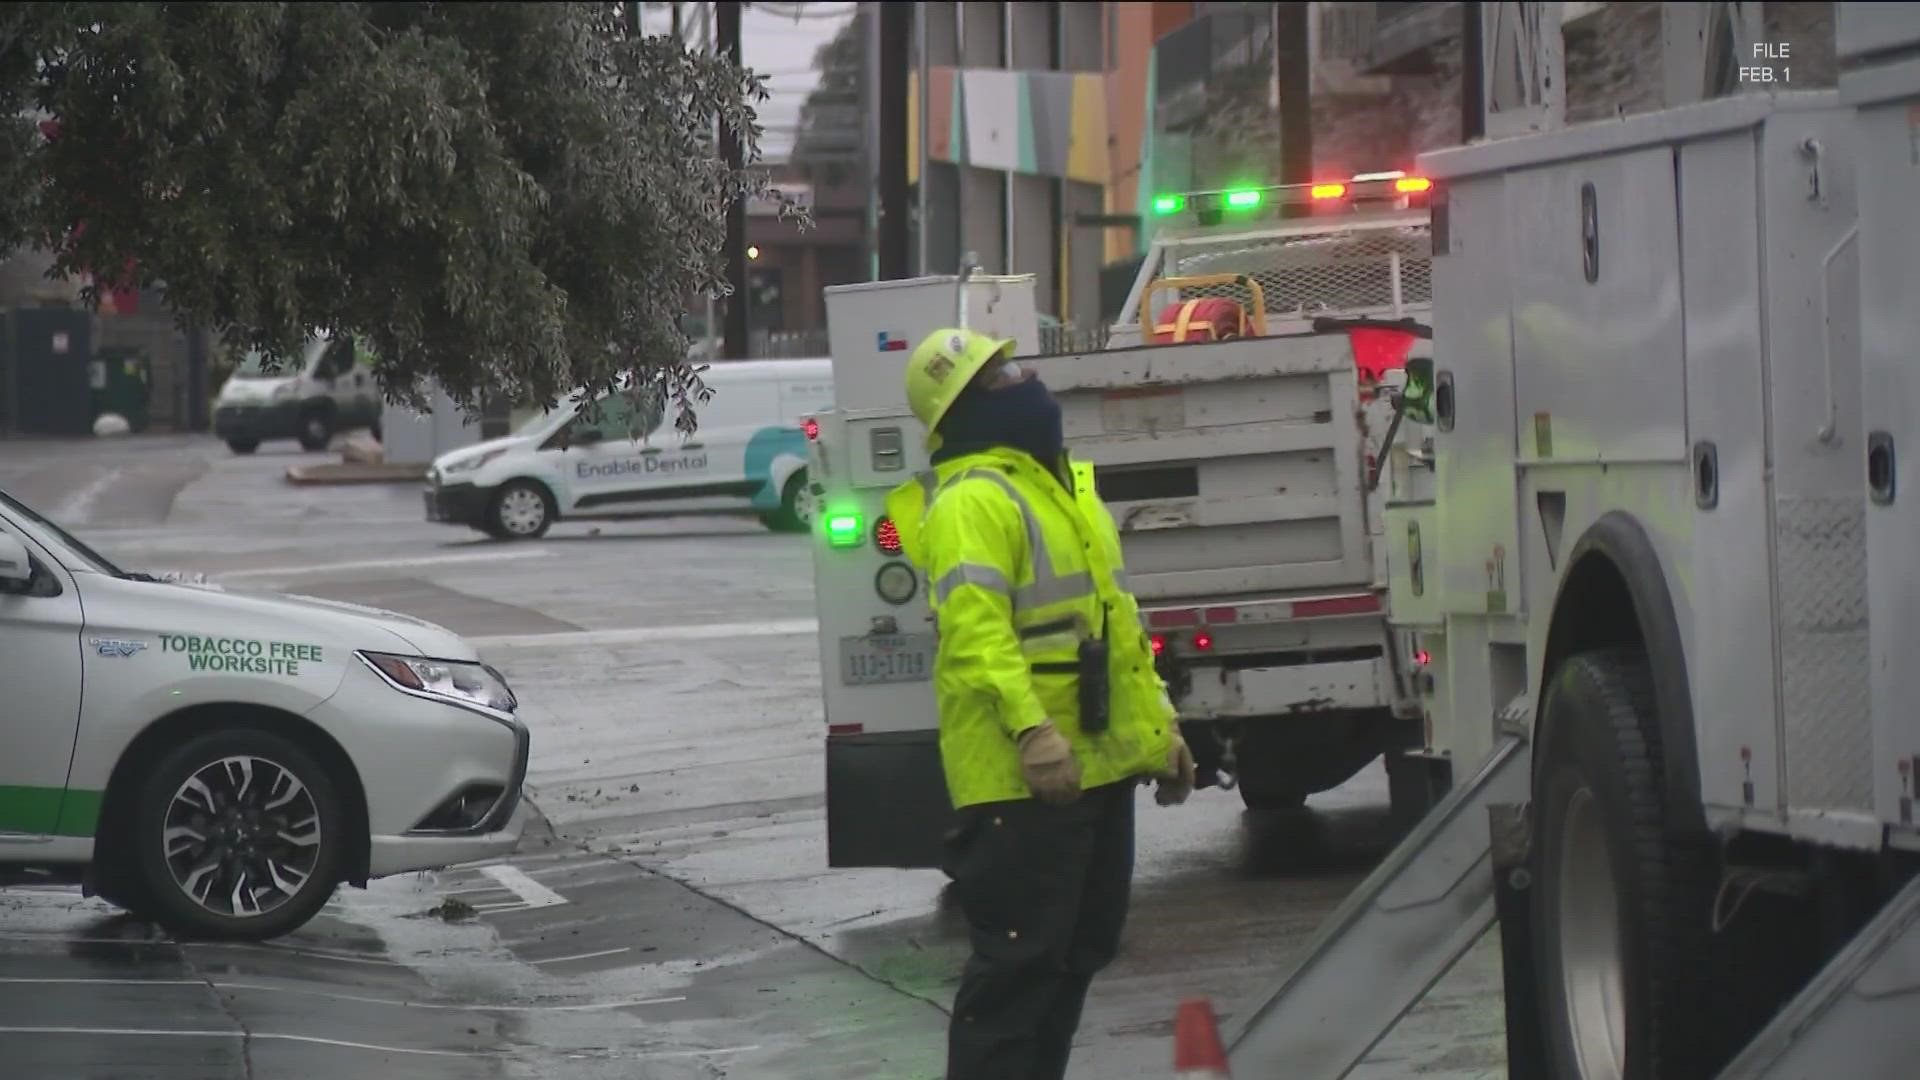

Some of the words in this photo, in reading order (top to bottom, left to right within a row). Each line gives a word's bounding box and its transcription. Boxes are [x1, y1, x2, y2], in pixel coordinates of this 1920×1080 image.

[576, 456, 641, 479] Enable
[645, 454, 708, 473] Dental
[158, 634, 263, 656] TOBACCO
[269, 641, 324, 662] FREE
[188, 653, 299, 676] WORKSITE
